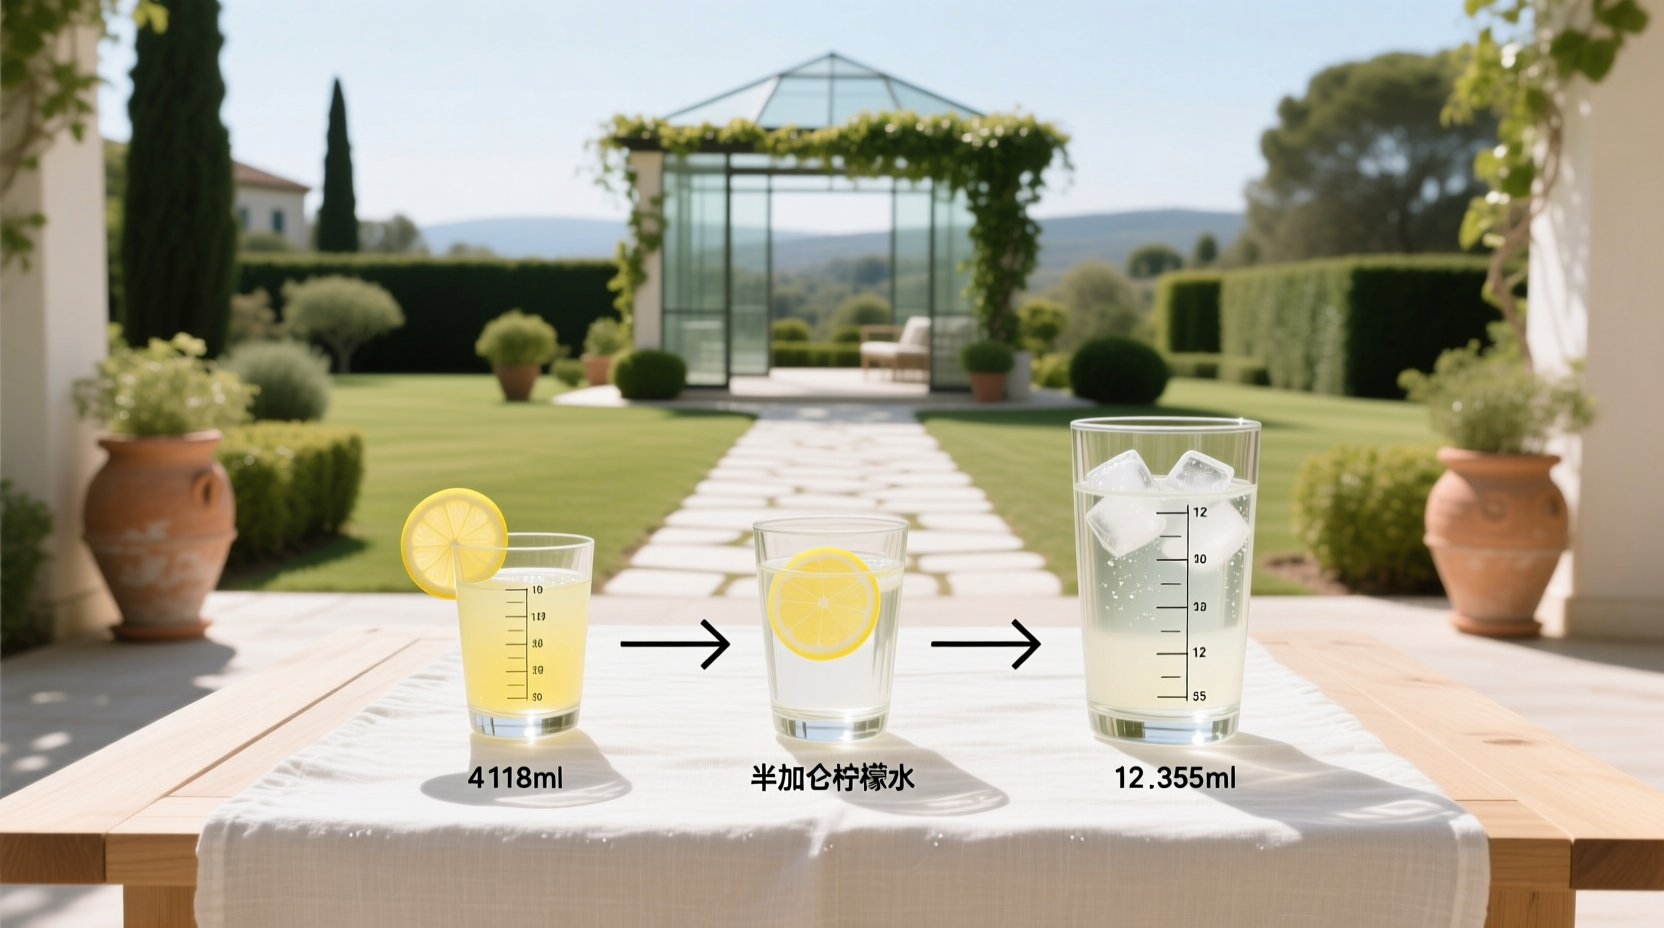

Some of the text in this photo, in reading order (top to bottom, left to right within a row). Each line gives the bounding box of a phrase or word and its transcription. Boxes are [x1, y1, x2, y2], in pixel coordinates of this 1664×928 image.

[1193, 506, 1208, 518] 12
[532, 585, 544, 595] 10
[1193, 646, 1207, 658] 12
